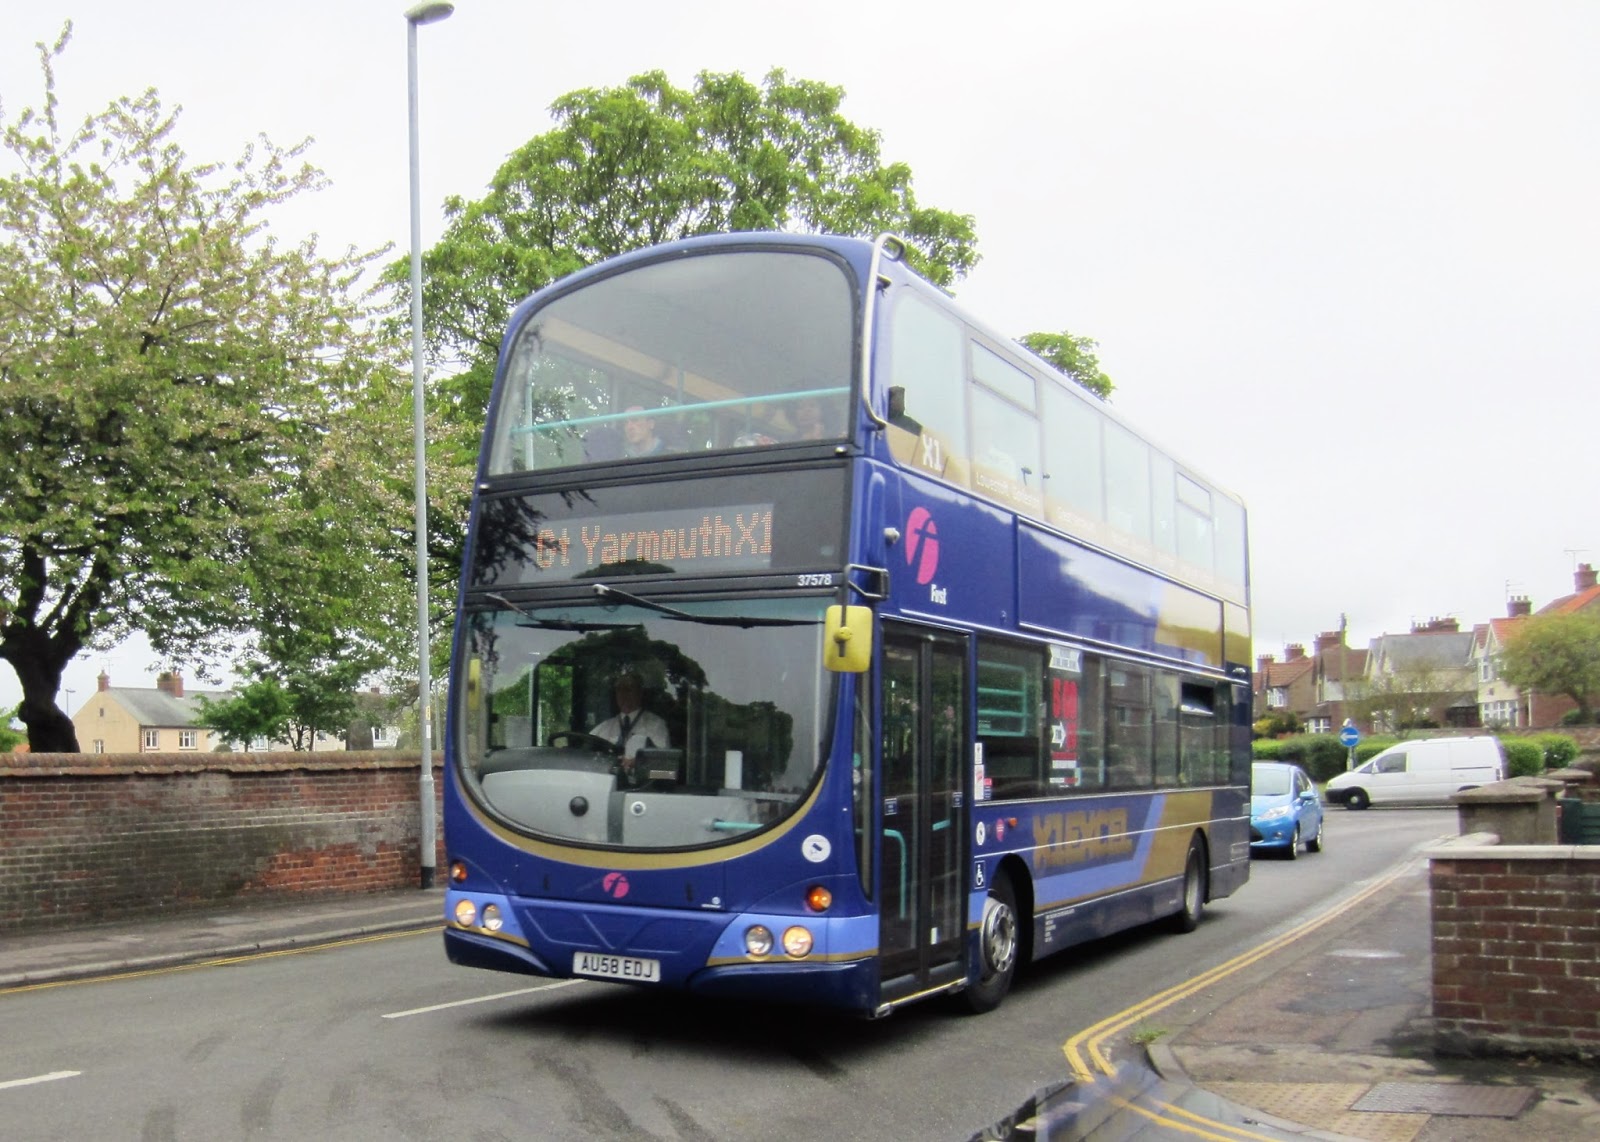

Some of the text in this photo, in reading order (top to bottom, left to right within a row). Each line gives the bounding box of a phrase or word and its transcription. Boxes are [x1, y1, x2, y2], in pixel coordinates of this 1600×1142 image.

[922, 434, 943, 471] X1
[580, 515, 732, 565] Yarmouth
[797, 574, 831, 587] 37578
[581, 956, 653, 977] AU58 EDJ
